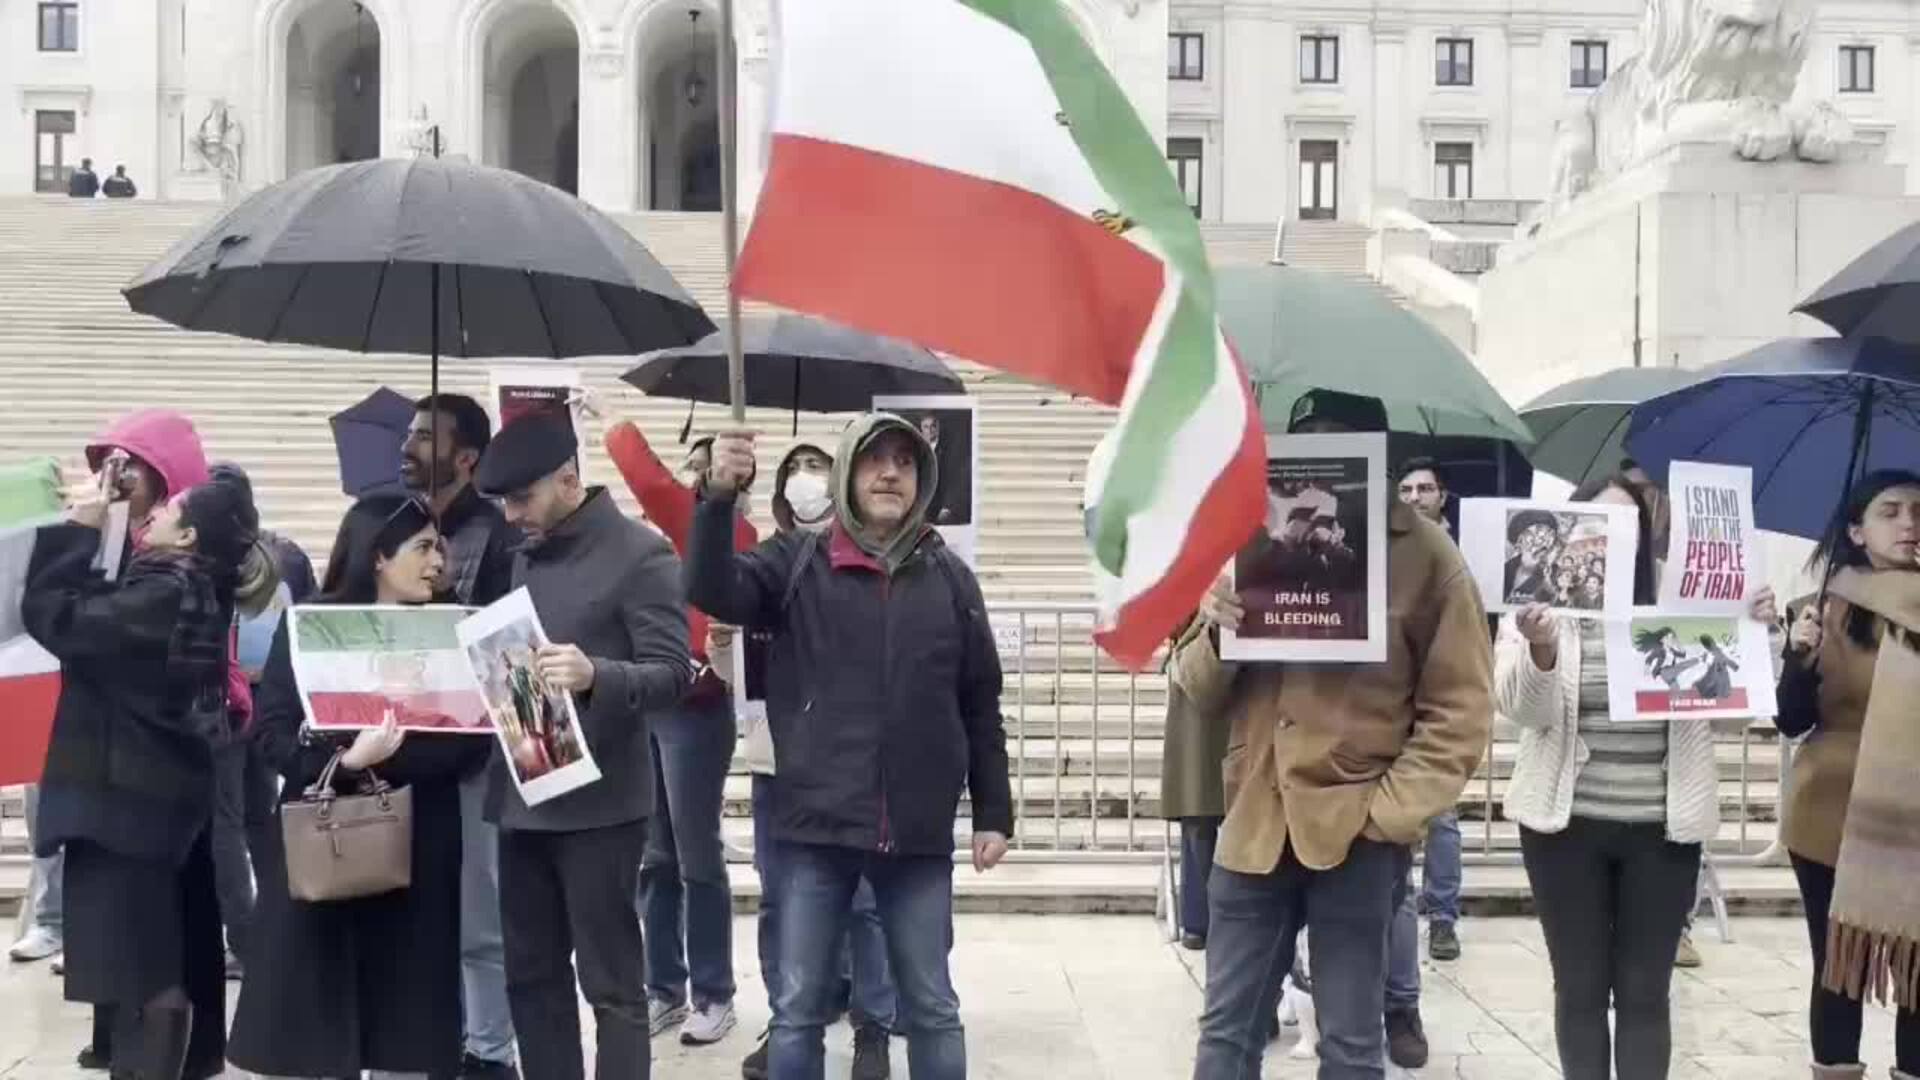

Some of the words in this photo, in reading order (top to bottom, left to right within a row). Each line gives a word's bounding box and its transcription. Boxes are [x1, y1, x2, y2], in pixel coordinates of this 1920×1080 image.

[1685, 485, 1691, 514] I
[1694, 486, 1739, 517] STAND
[1688, 516, 1720, 540] WITH
[1722, 517, 1742, 542] THE
[1685, 541, 1745, 571] PEOPLE
[1275, 592, 1312, 605] IRAN
[1316, 592, 1331, 605] IS
[1680, 571, 1704, 598] OF
[1704, 573, 1744, 600] IRAN
[1264, 612, 1341, 625] BLEEDING
